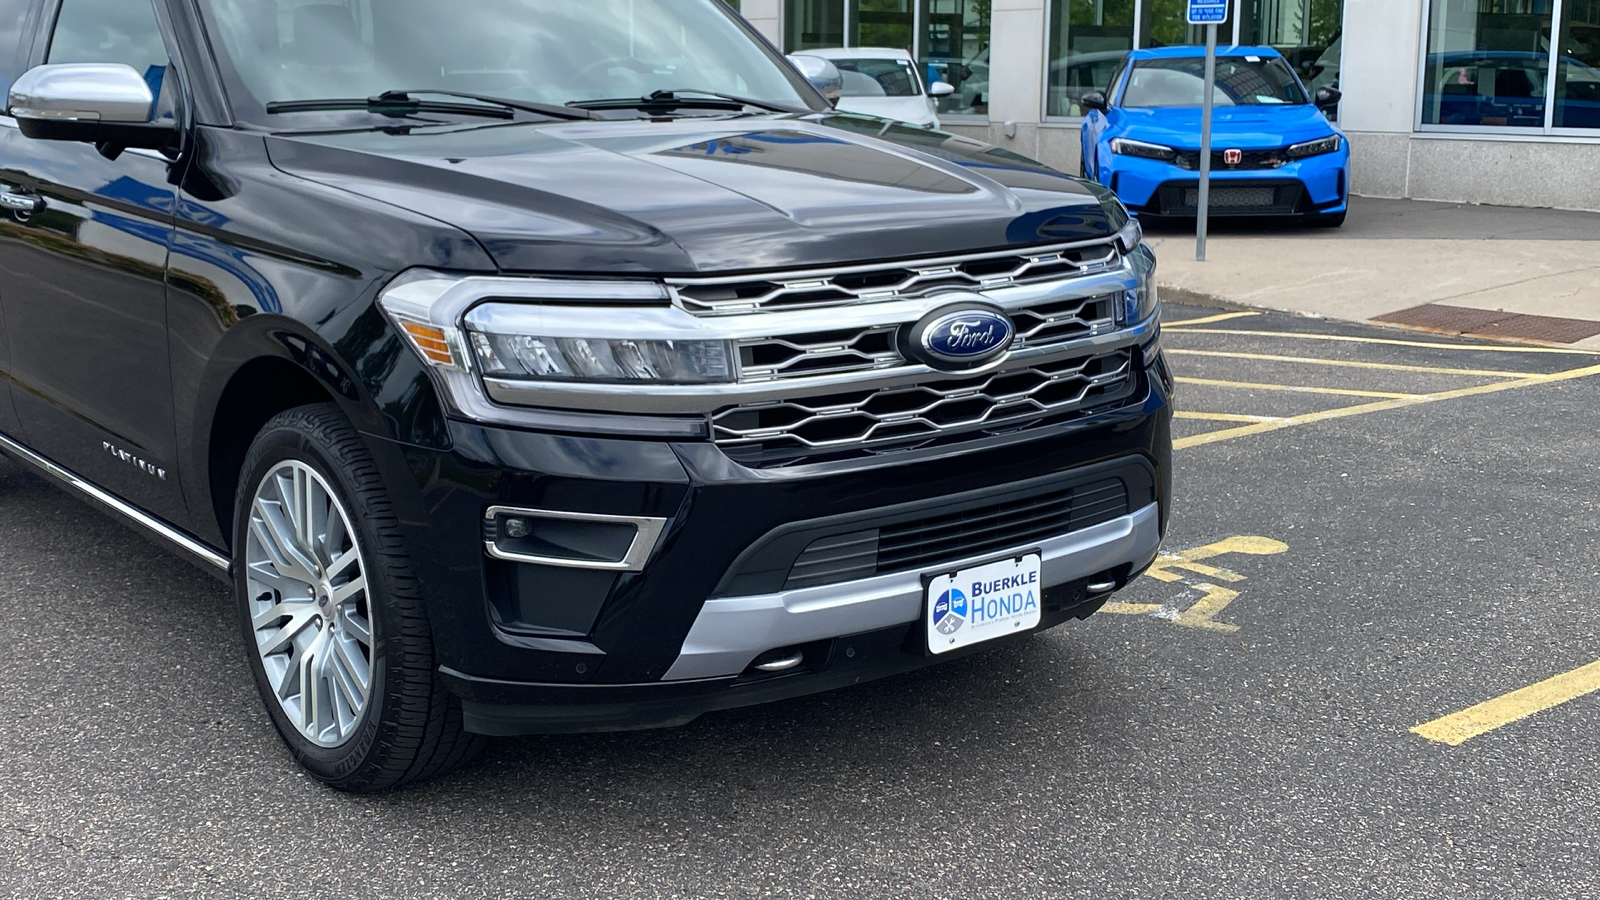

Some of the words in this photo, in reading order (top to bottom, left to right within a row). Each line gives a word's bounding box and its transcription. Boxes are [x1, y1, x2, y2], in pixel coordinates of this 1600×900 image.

[947, 320, 994, 349] Ford
[102, 441, 167, 480] PLATINUM
[971, 590, 1037, 624] HONDA
[335, 719, 377, 775] WRANGLER
